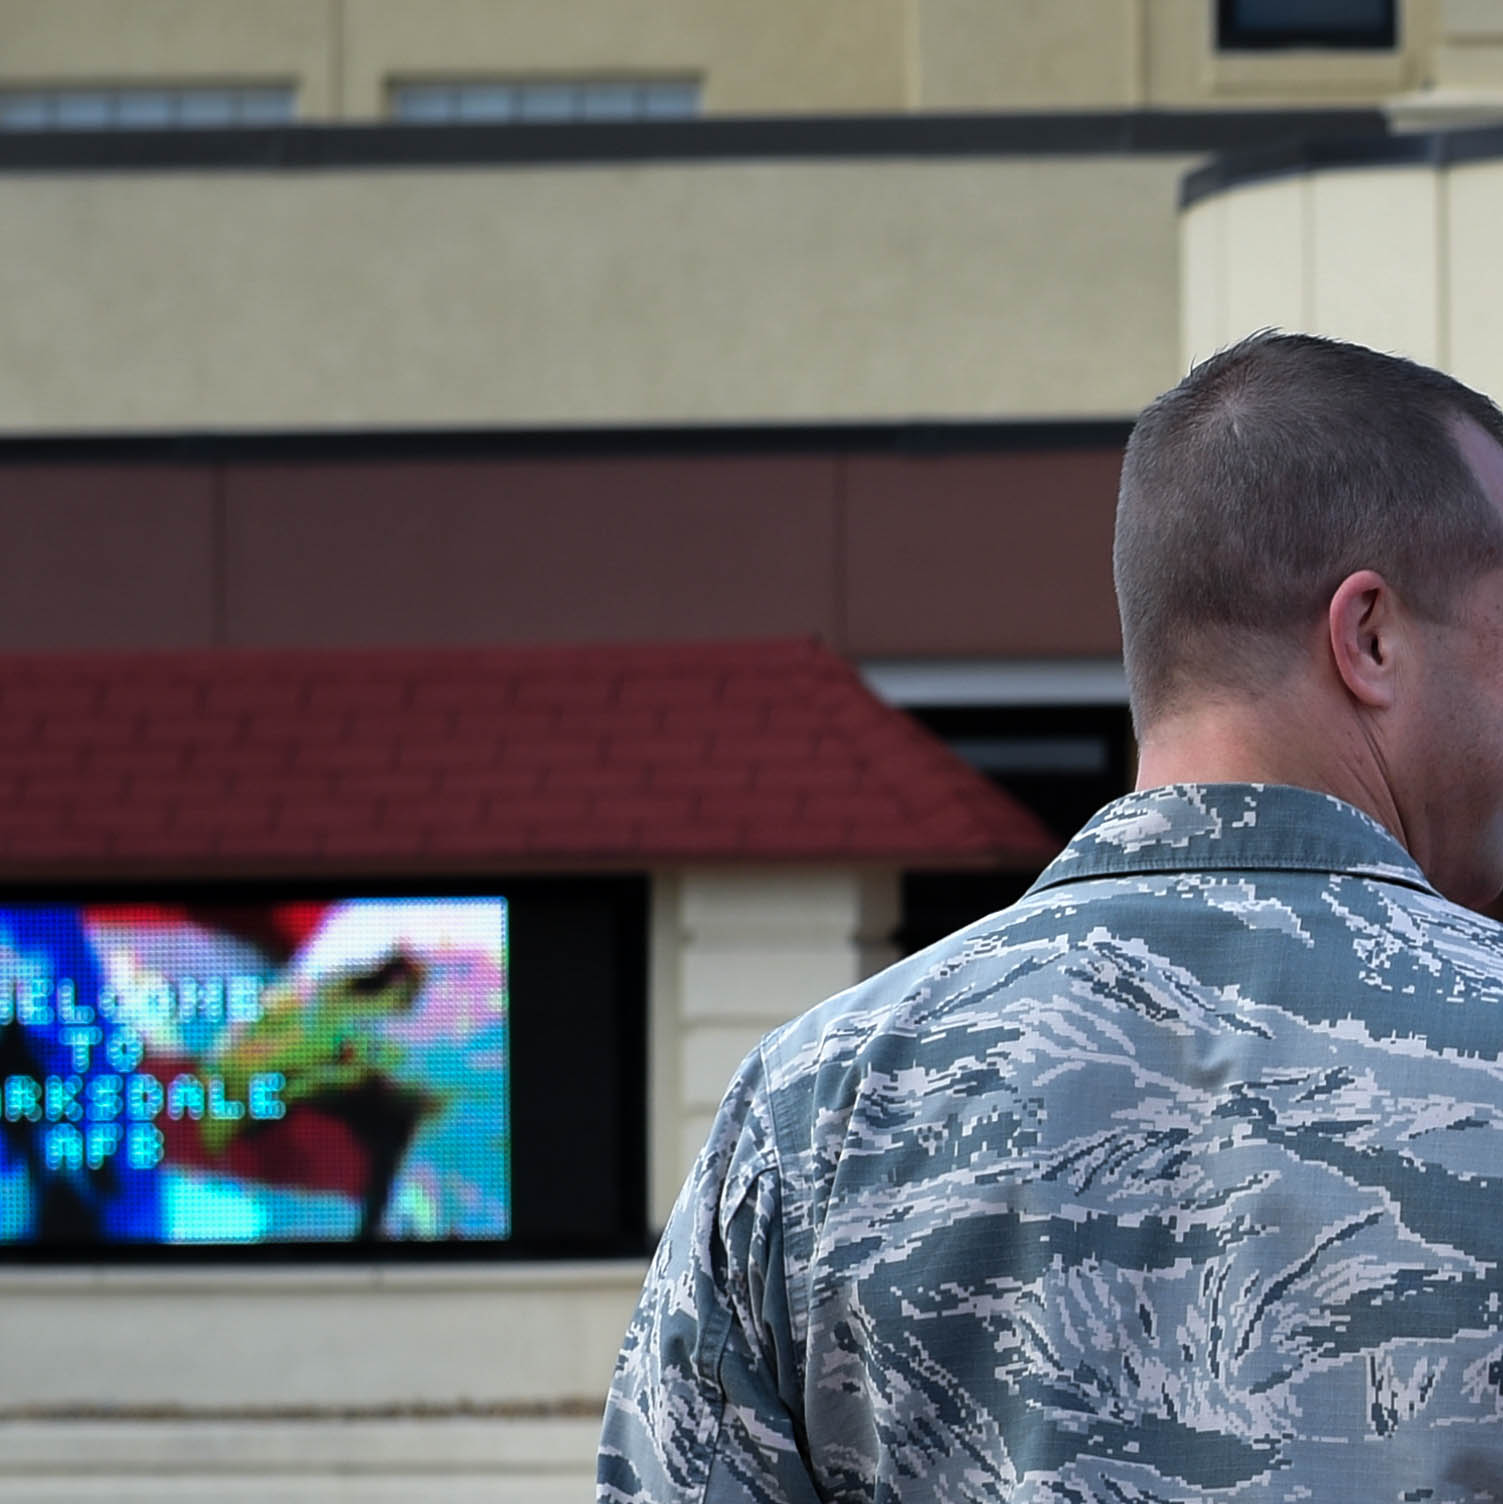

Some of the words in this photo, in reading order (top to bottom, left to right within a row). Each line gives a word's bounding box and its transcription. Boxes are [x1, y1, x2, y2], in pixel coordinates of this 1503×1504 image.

[58, 1025, 144, 1073] TO
[0, 1073, 286, 1122] RKSDALE
[45, 1122, 165, 1171] AFB
